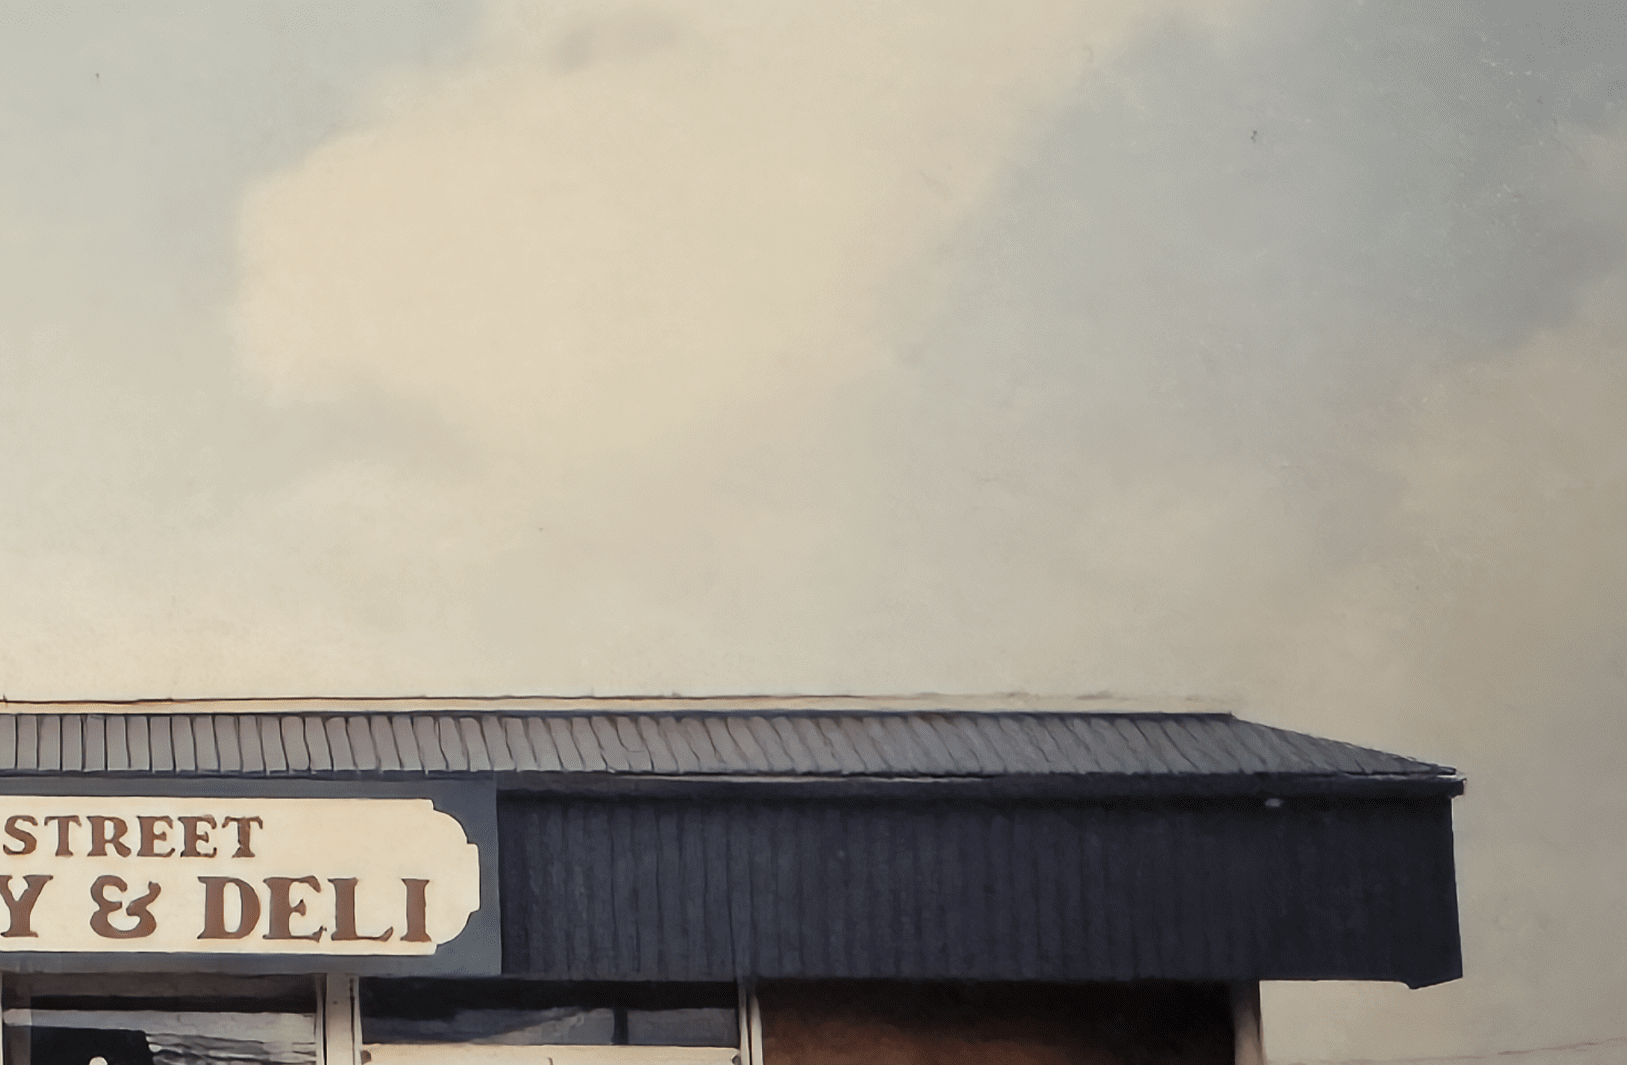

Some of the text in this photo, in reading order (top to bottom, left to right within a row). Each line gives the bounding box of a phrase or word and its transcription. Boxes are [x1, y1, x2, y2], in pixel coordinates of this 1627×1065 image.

[3, 814, 263, 858] STREET
[90, 875, 161, 939] &
[197, 875, 432, 942] DELI
